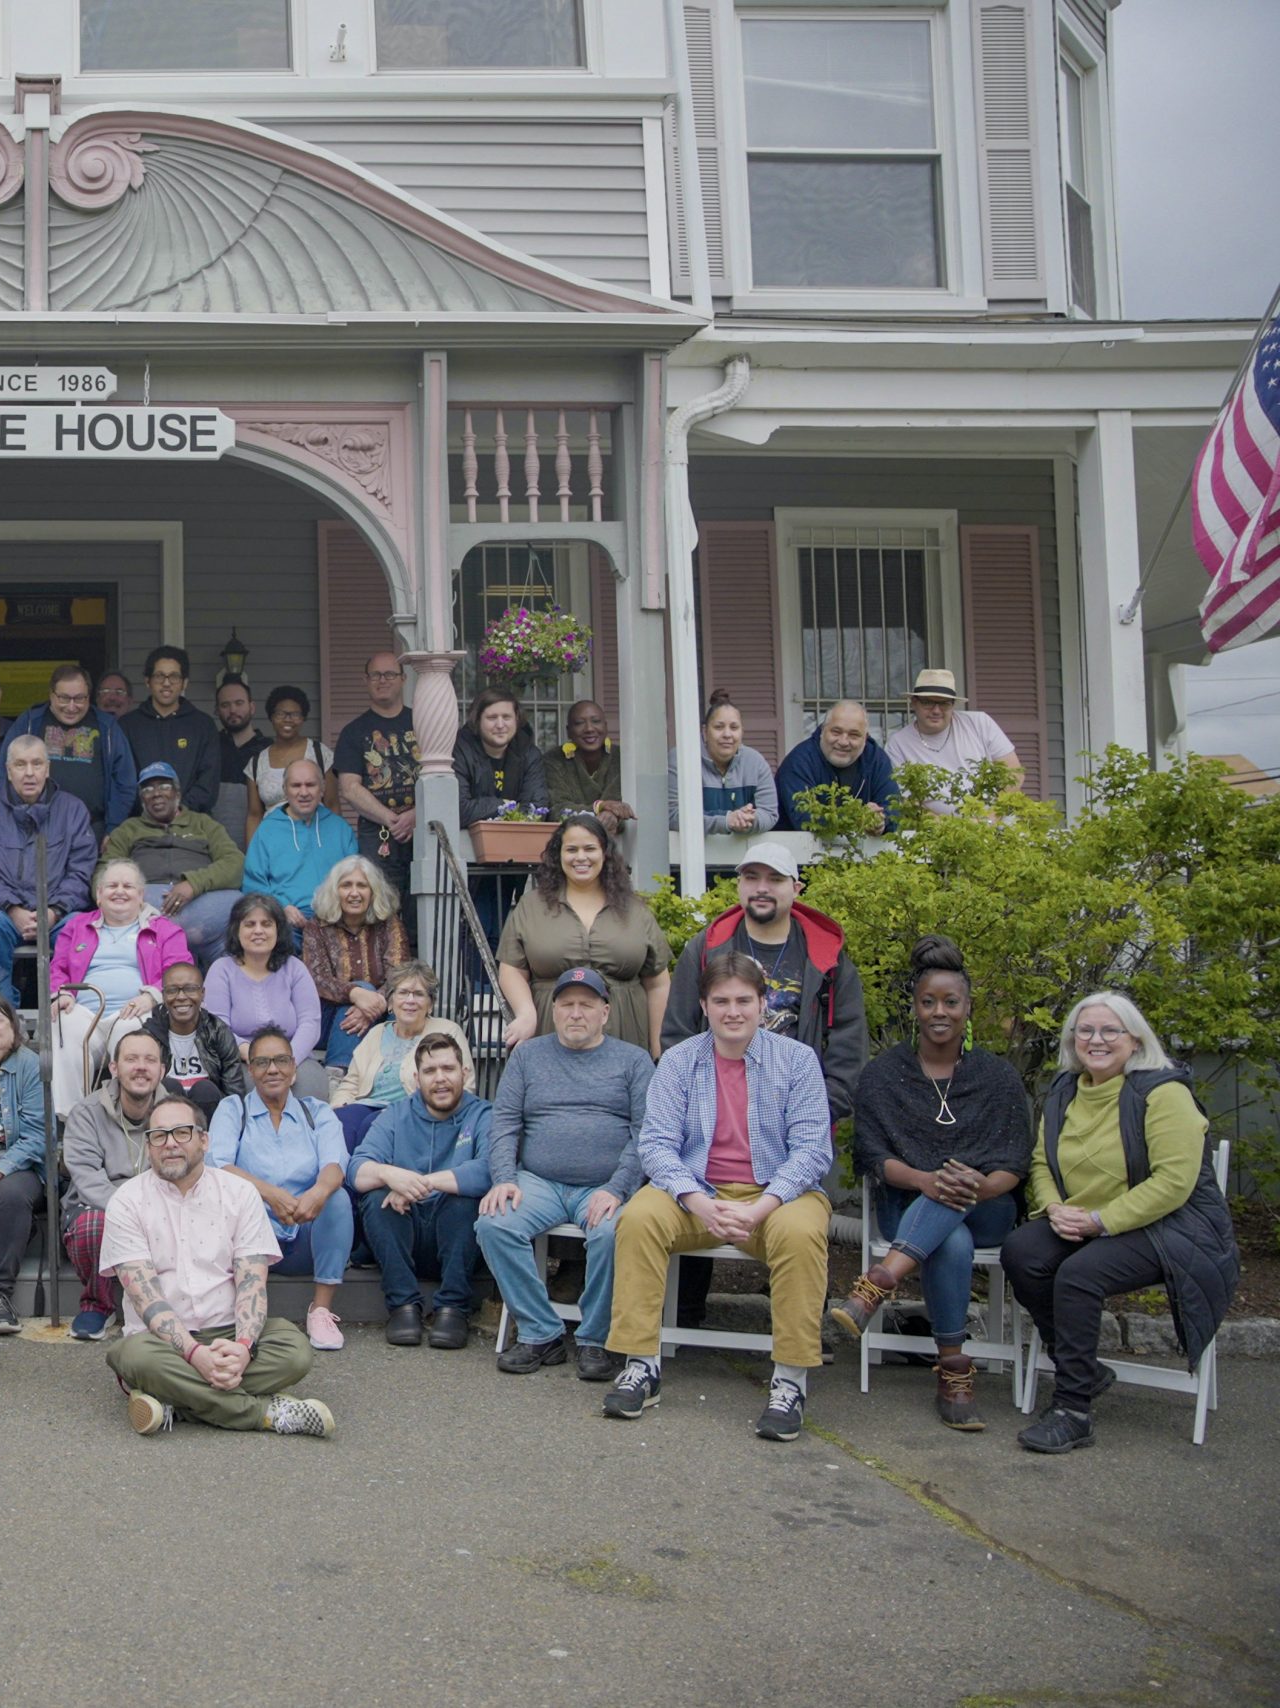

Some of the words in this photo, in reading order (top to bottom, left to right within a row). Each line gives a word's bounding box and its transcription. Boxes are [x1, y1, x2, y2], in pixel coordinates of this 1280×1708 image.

[57, 374, 107, 392] 1986
[55, 413, 218, 453] HOUSE
[17, 603, 60, 617] WELCOME
